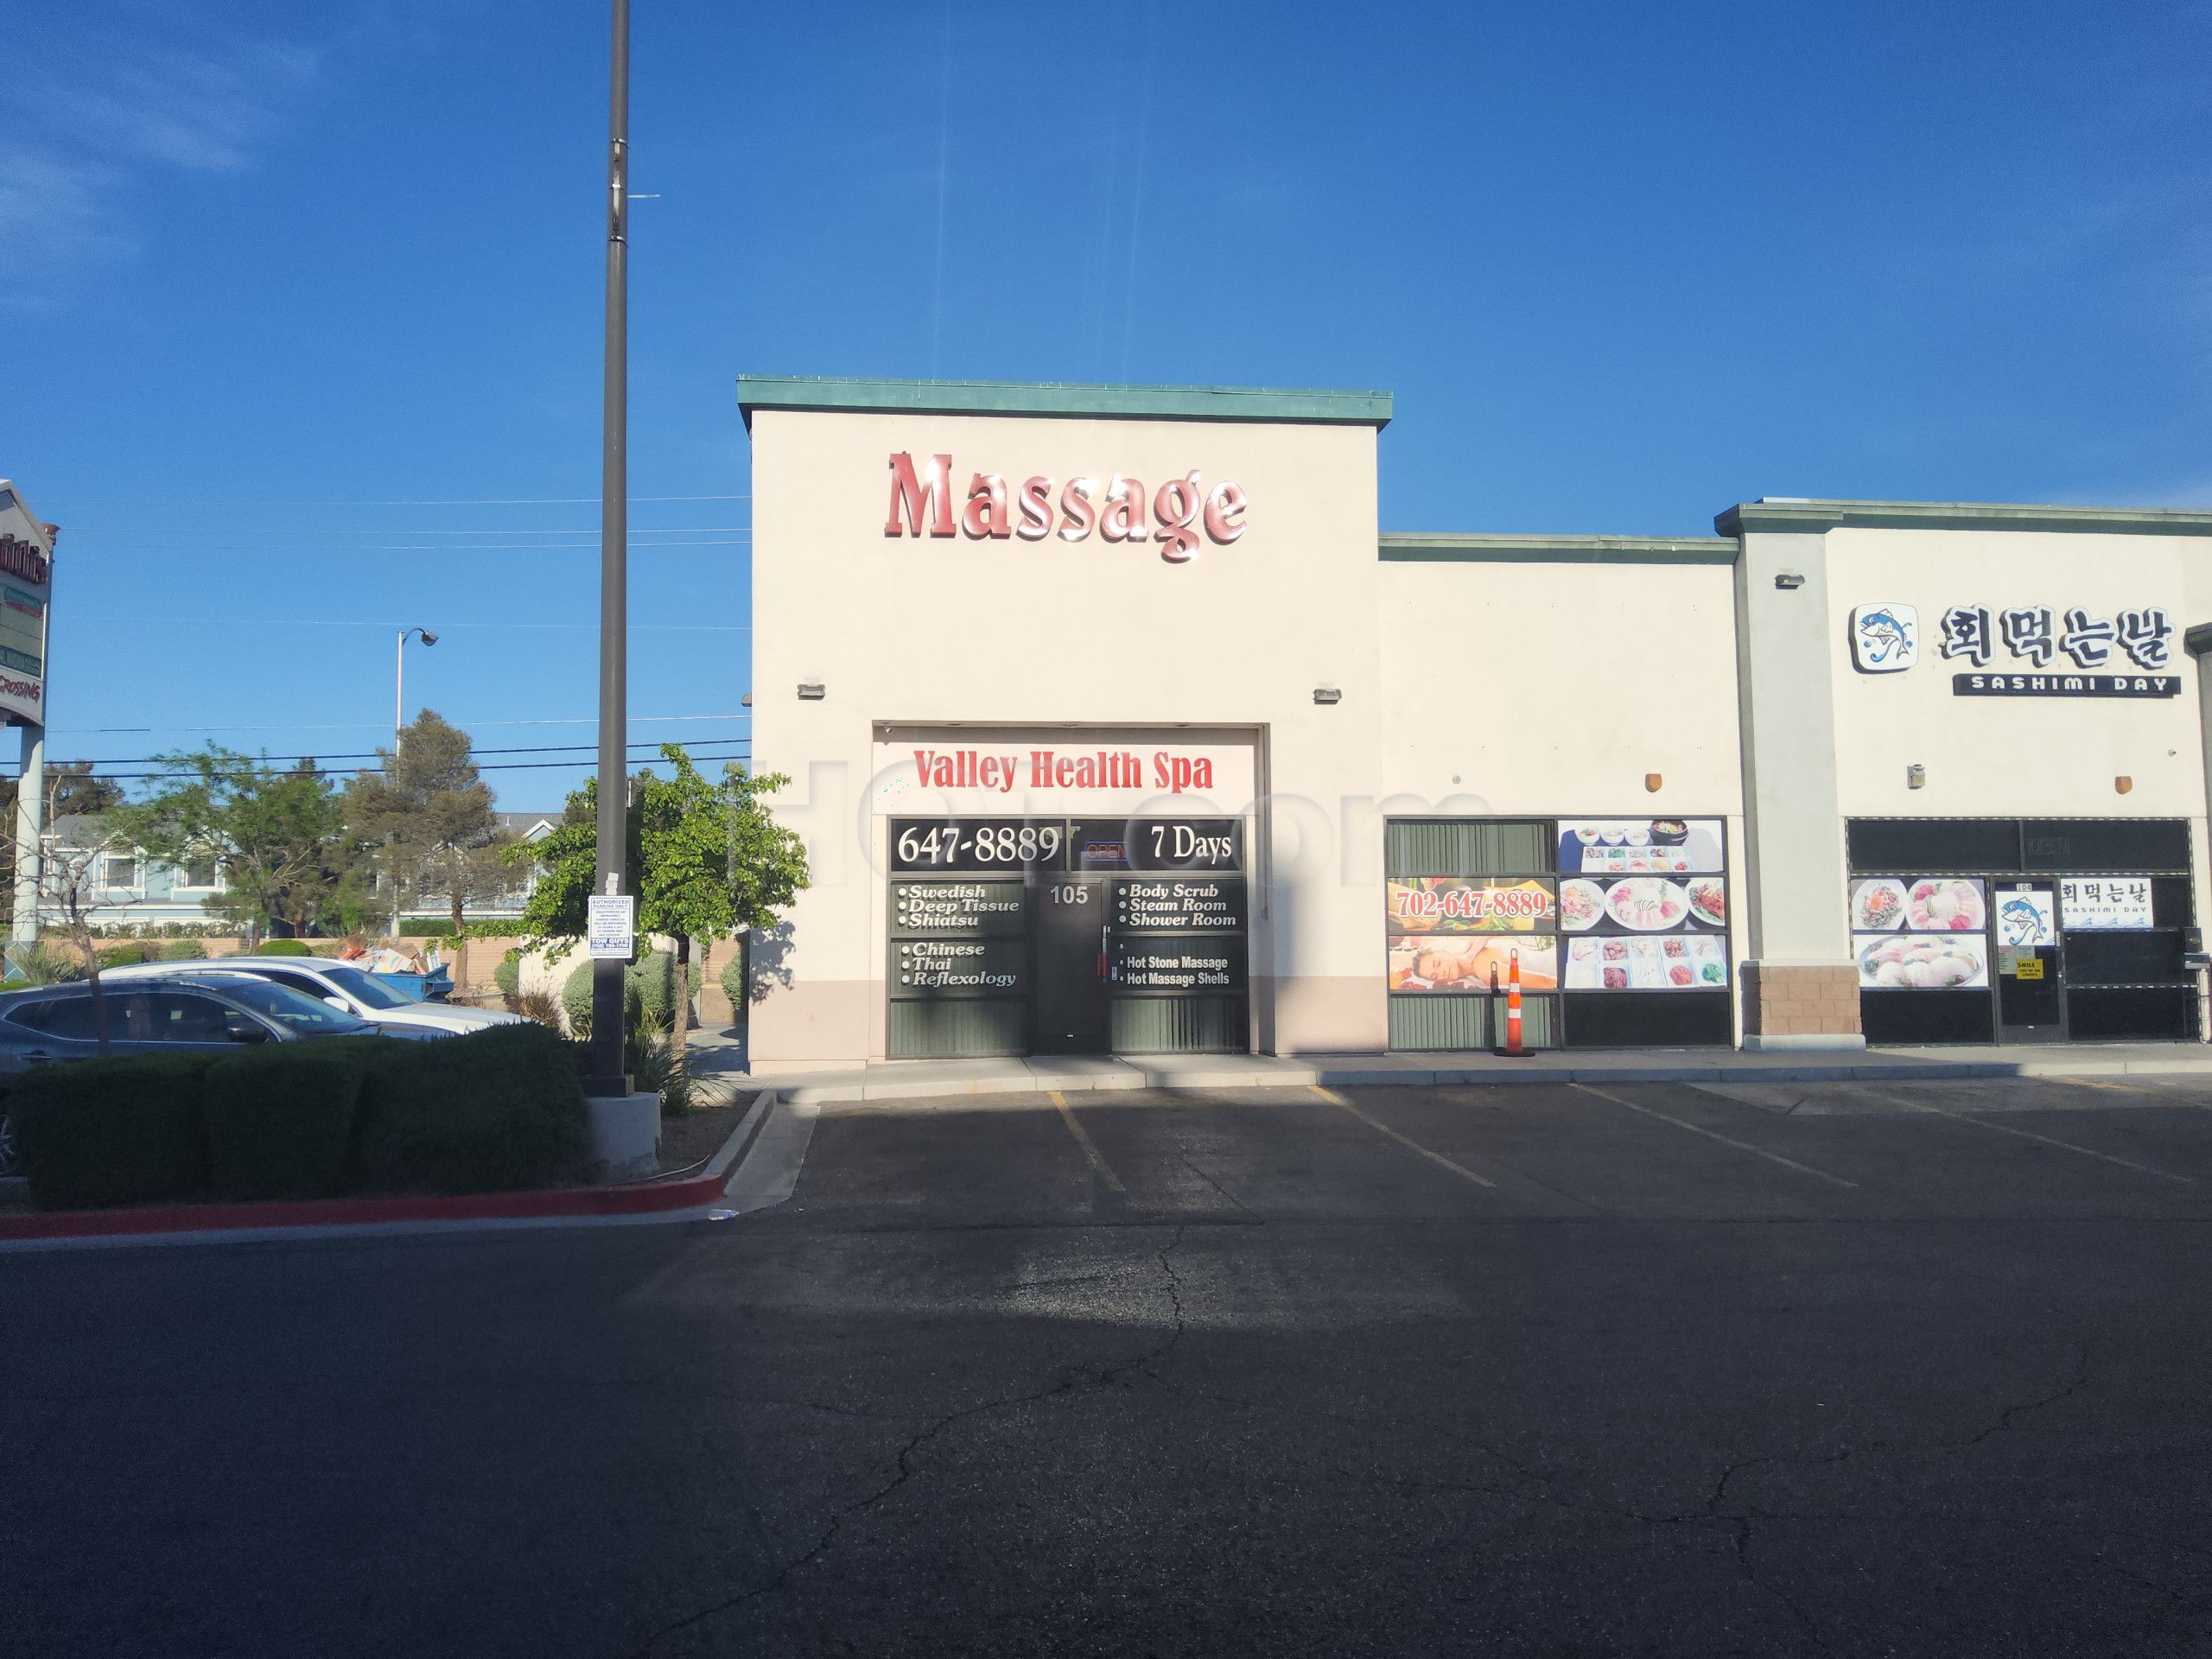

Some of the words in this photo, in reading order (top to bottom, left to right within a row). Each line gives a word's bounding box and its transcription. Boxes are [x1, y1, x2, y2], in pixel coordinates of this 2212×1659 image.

[885, 452, 1247, 563] Massage
[1972, 677, 2095, 690] SASHIMI
[2114, 677, 2167, 690] DAY
[913, 750, 1018, 792] Valley
[1030, 751, 1142, 788] Health
[1154, 751, 1213, 793] Spa
[898, 827, 1059, 864] 647-8889
[1086, 844, 1127, 859] OPEN
[1151, 826, 1164, 858] 7
[1173, 825, 1232, 865] Days
[908, 885, 986, 899] Swedish
[1050, 886, 1089, 904] 105
[1129, 884, 1169, 899] Body
[1173, 884, 1218, 898] Scrub
[908, 899, 957, 914] Deep
[962, 899, 1020, 912] Tissue
[1129, 899, 1178, 911] Steam
[1182, 899, 1227, 911] Room
[1395, 891, 1548, 918] 702-647-8889
[908, 913, 979, 926] Shiatsu
[1129, 912, 1188, 926] Shower
[1192, 913, 1236, 925] Room
[912, 942, 985, 956] Chinese
[912, 957, 952, 970] Thai
[1127, 957, 1146, 969] Hot
[1148, 957, 1179, 969] Stone
[1181, 957, 1228, 970] Massage
[912, 971, 1016, 987] Reflexology
[1127, 973, 1147, 984] Hot
[1149, 973, 1195, 987] Massage
[1198, 972, 1230, 984] Shells
